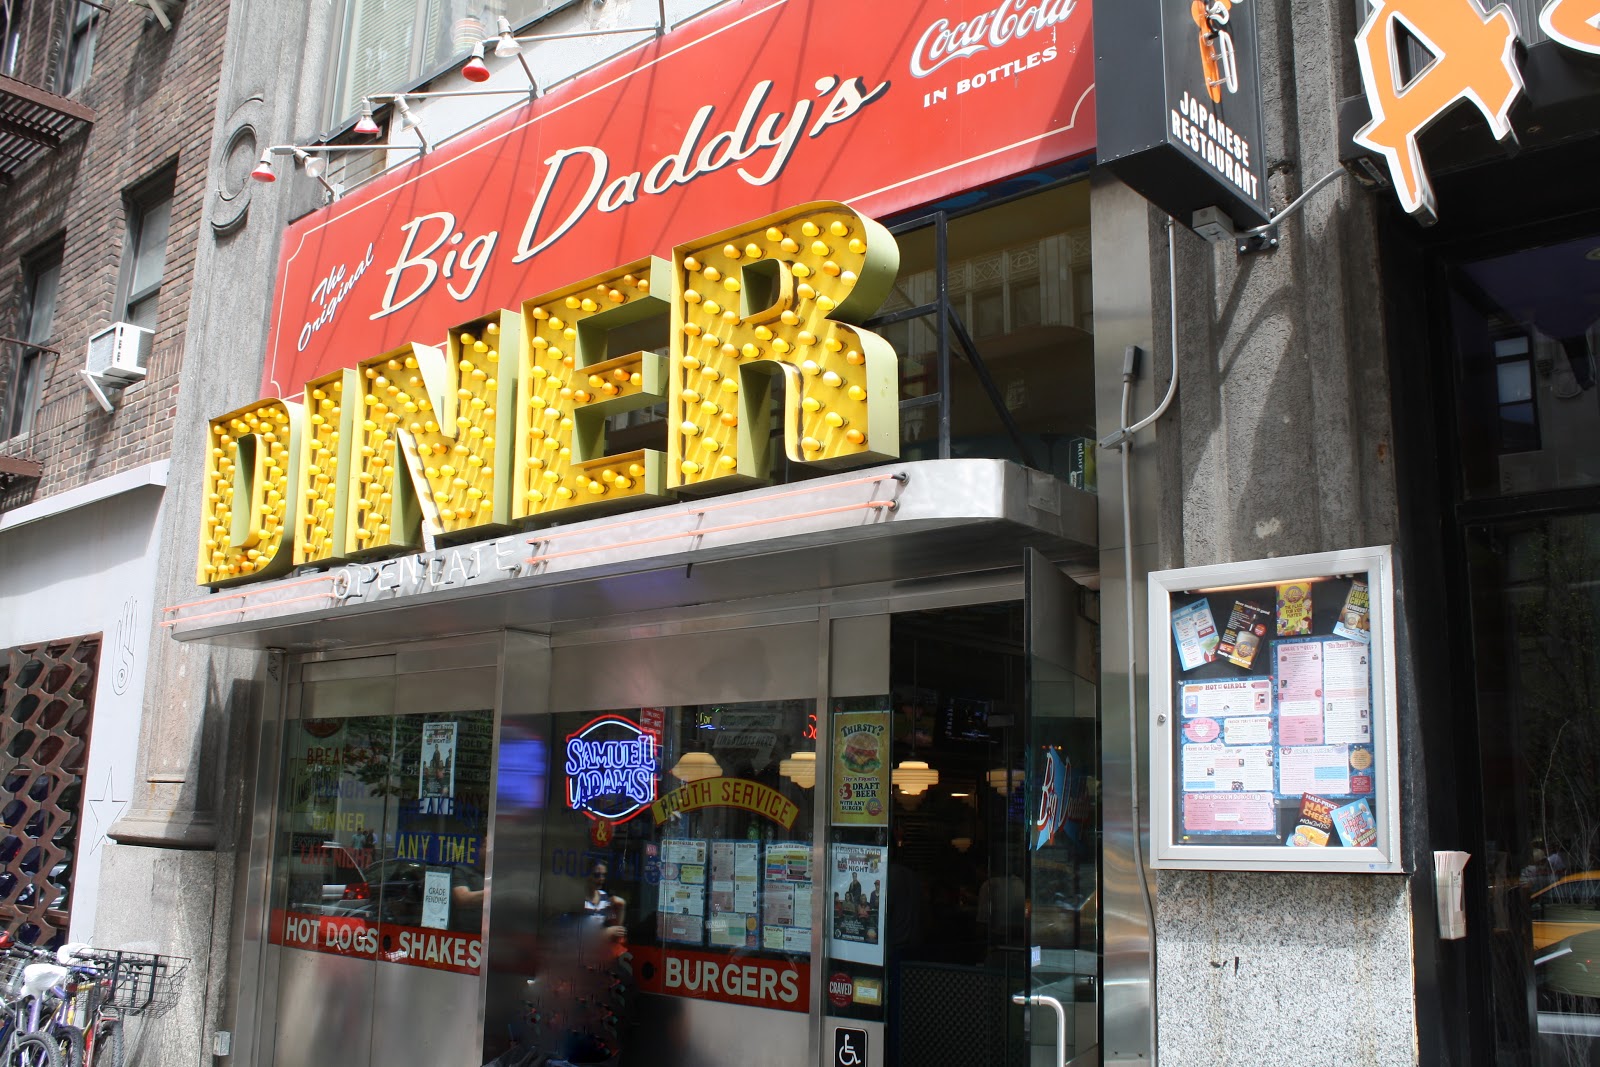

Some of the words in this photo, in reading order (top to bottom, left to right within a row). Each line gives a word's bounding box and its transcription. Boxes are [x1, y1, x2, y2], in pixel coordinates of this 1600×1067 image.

[910, 0, 1078, 78] Coca-Cola
[923, 87, 948, 108] IN
[956, 45, 1058, 95] BOTTLES
[1180, 91, 1250, 167] JAPANESE
[1171, 109, 1258, 200] RESTAURANT
[369, 211, 498, 321] Big
[512, 74, 889, 264] Daddy's
[298, 243, 374, 352] Original
[311, 264, 346, 306] The
[196, 200, 899, 588] DINER
[334, 554, 419, 599] OPEN
[429, 537, 516, 587] LATE
[1349, 597, 1369, 607] CHICK
[841, 723, 885, 738] THIRSTY?
[565, 735, 655, 776] SAMUEL
[571, 769, 650, 809] ADAMS
[722, 781, 791, 823] SERVICE
[839, 783, 852, 800] $3
[852, 782, 880, 790] DRAFT
[855, 790, 877, 798] BEER
[1304, 801, 1328, 815] MAC
[313, 812, 366, 832] DINNER
[596, 820, 608, 843] &
[1302, 809, 1332, 825] CHEESE
[397, 833, 430, 860] ANY
[438, 835, 477, 864] TIME
[848, 865, 869, 873] NIGHT
[286, 916, 322, 945] HOT
[325, 922, 378, 954] DOGS
[399, 931, 482, 968] SHAKES
[665, 957, 799, 1003] BURGERS
[829, 981, 853, 996] CRAVED
